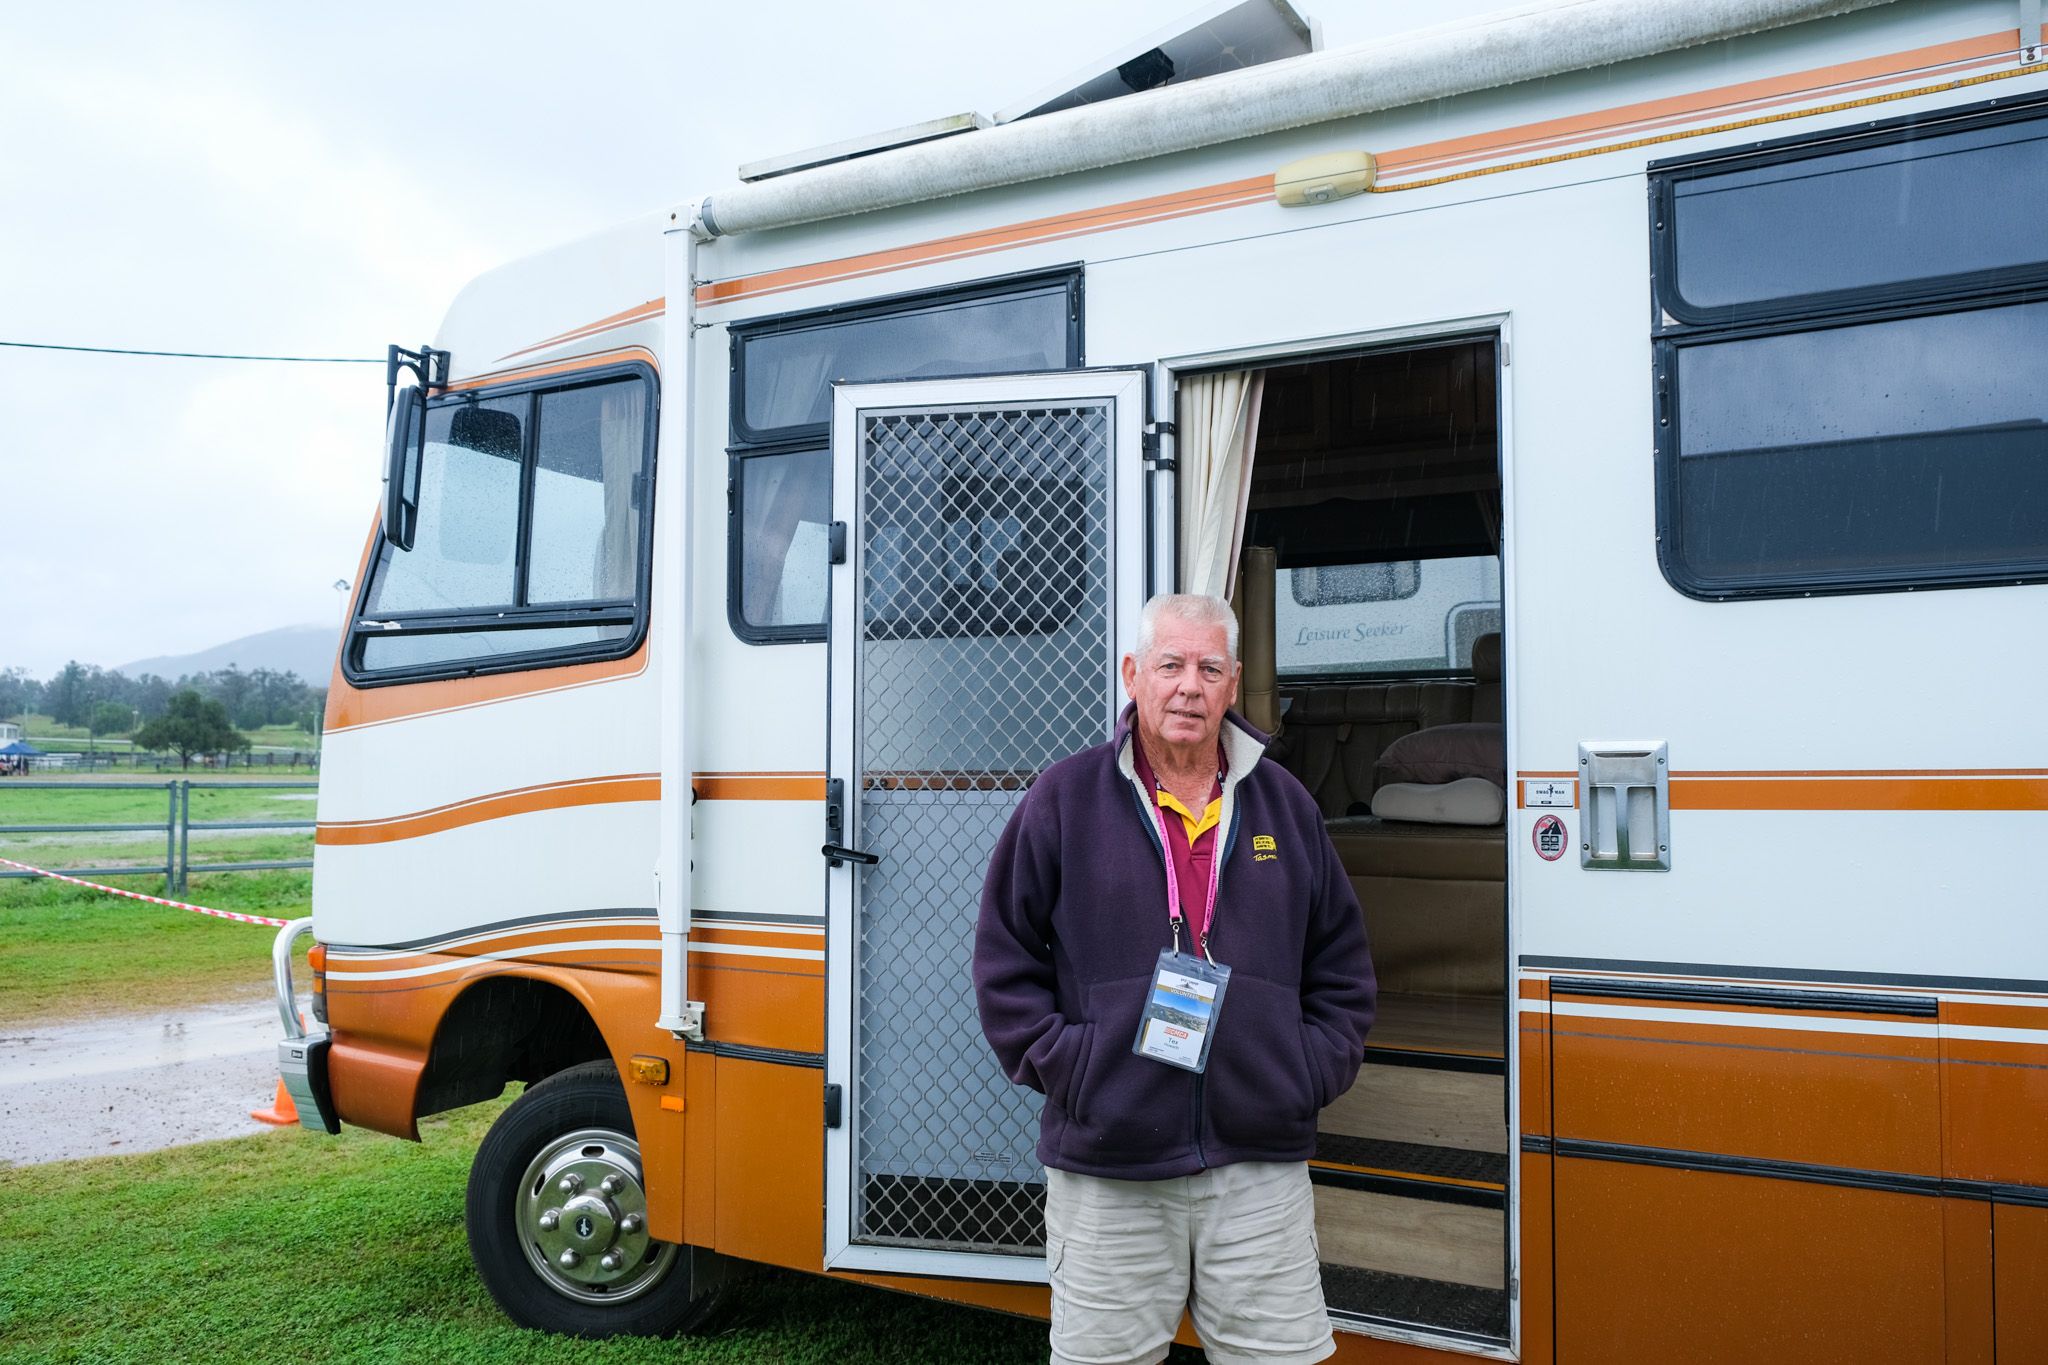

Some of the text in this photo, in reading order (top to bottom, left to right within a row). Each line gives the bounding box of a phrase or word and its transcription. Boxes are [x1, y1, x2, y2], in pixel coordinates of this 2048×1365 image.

[1294, 622, 1409, 646] Leisure Seeker
[1168, 1037, 1179, 1045] Tex
